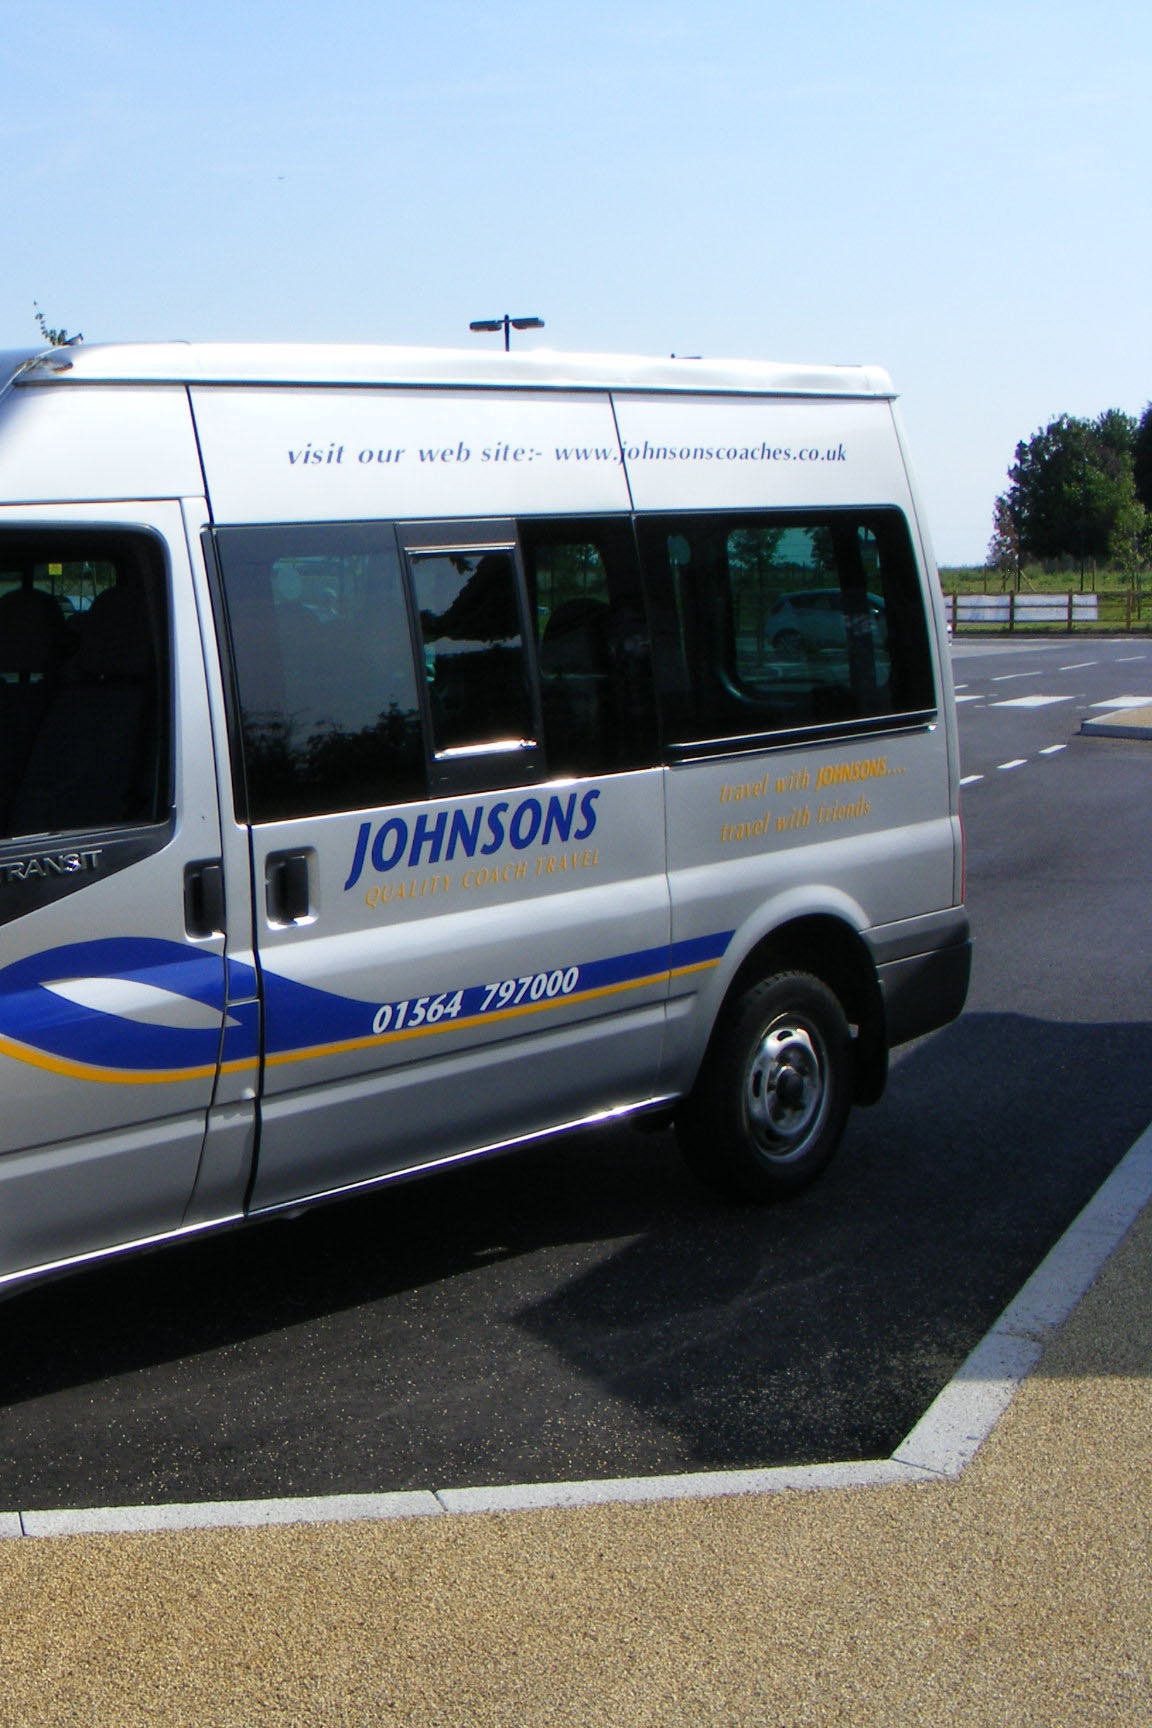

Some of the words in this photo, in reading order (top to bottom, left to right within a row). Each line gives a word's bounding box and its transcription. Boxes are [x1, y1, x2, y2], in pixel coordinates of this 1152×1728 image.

[288, 443, 344, 464] visit
[359, 447, 406, 464] our
[419, 442, 471, 463] web
[555, 441, 847, 464] www.johnsonscoaches.co.uk
[720, 773, 769, 803] travel
[775, 767, 810, 794] with
[344, 789, 601, 891] JOHNSONS
[720, 811, 770, 843] travel
[775, 804, 811, 832] with
[817, 795, 871, 825] friends
[365, 876, 452, 909] QUALITY
[461, 860, 529, 889] COACH
[535, 849, 600, 876] TRAVEL
[372, 990, 464, 1034] 01564
[480, 966, 580, 1011] 797000
